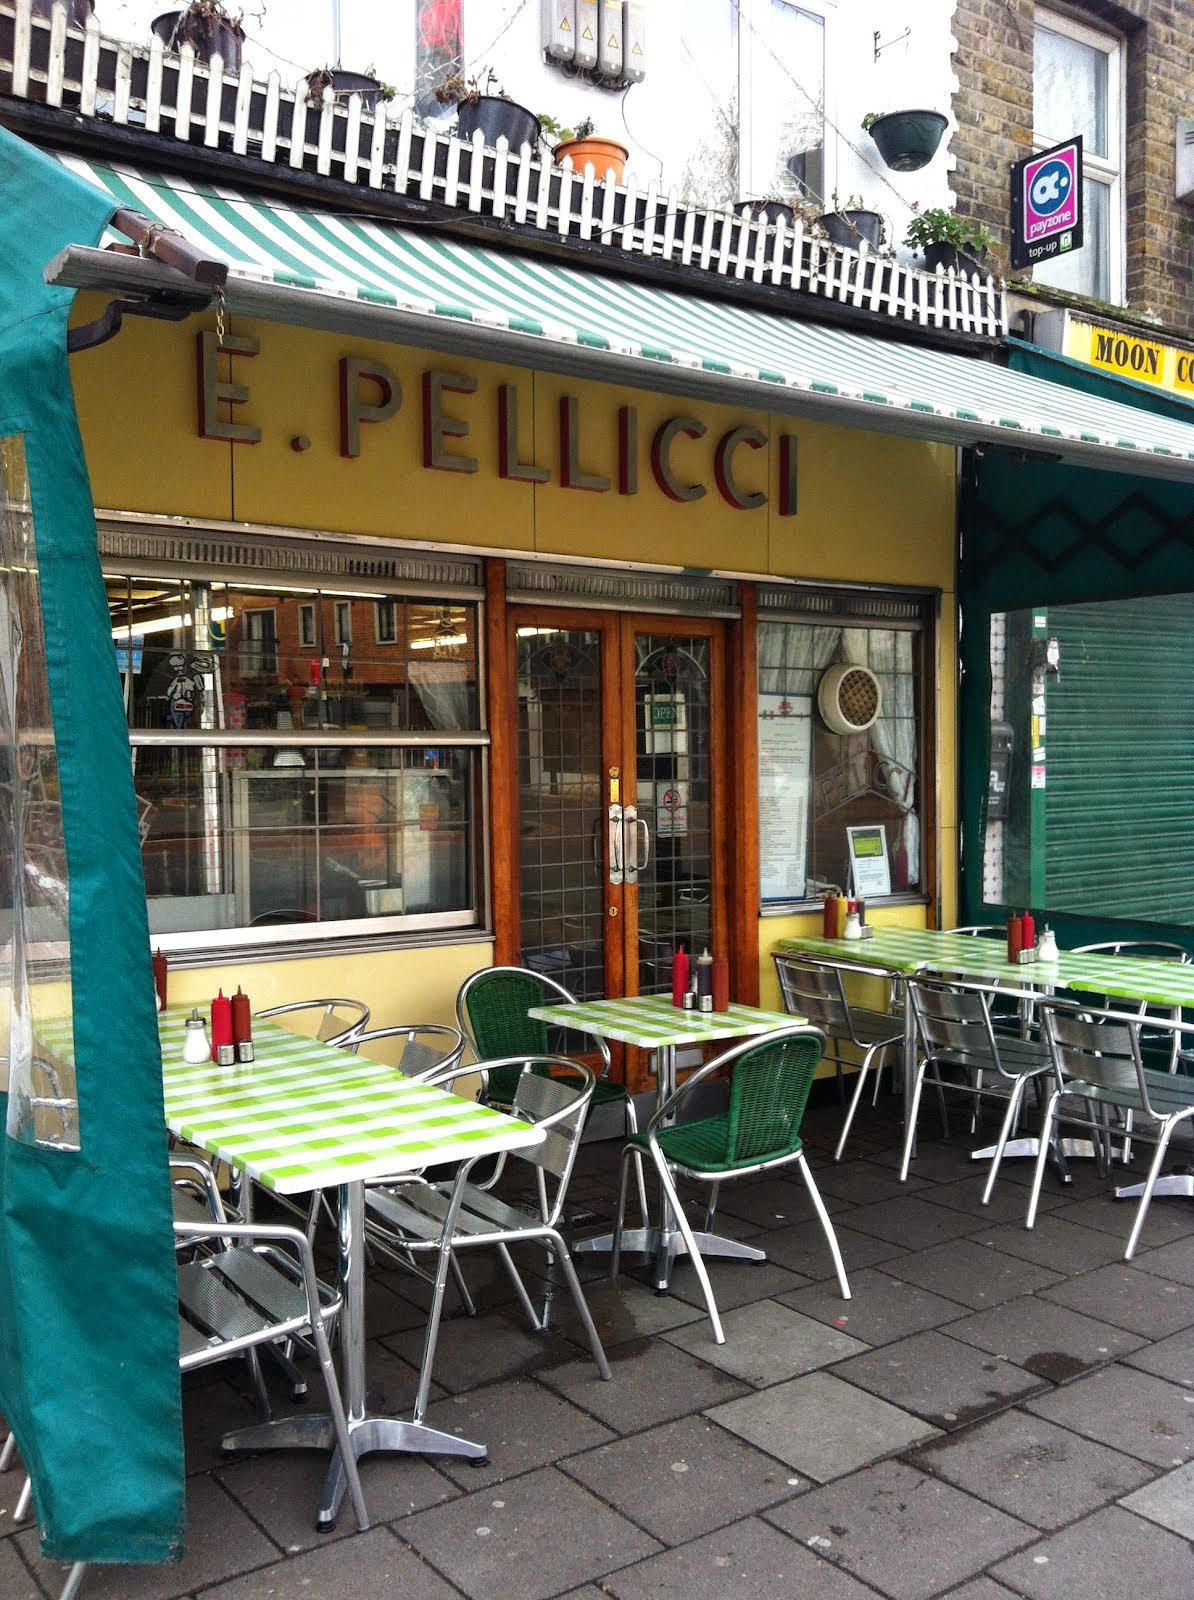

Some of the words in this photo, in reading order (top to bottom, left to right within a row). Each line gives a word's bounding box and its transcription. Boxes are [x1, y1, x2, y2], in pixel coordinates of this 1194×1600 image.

[1030, 210, 1071, 238] payzone
[1029, 241, 1057, 257] top-up
[1095, 334, 1160, 375] MOON
[196, 331, 311, 453] E.
[339, 356, 797, 516] PELLICCI
[652, 706, 679, 720] OPEN
